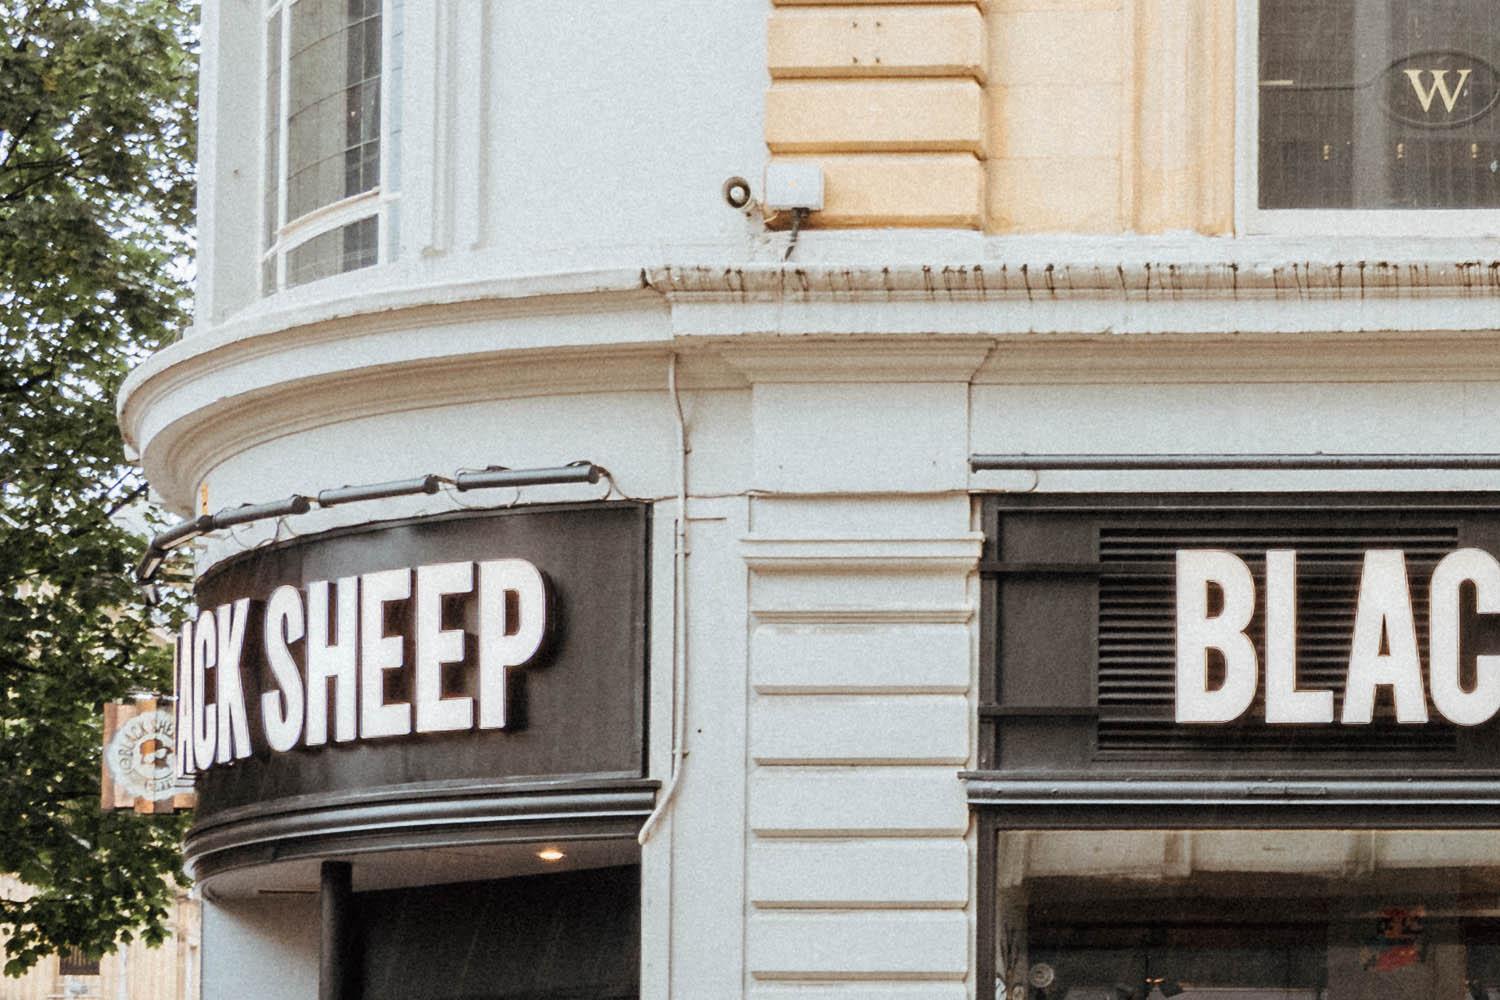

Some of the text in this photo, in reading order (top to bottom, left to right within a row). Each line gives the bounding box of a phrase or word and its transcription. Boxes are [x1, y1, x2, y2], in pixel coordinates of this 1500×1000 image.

[1403, 68, 1472, 113] W
[176, 557, 547, 778] ACK SHEEP
